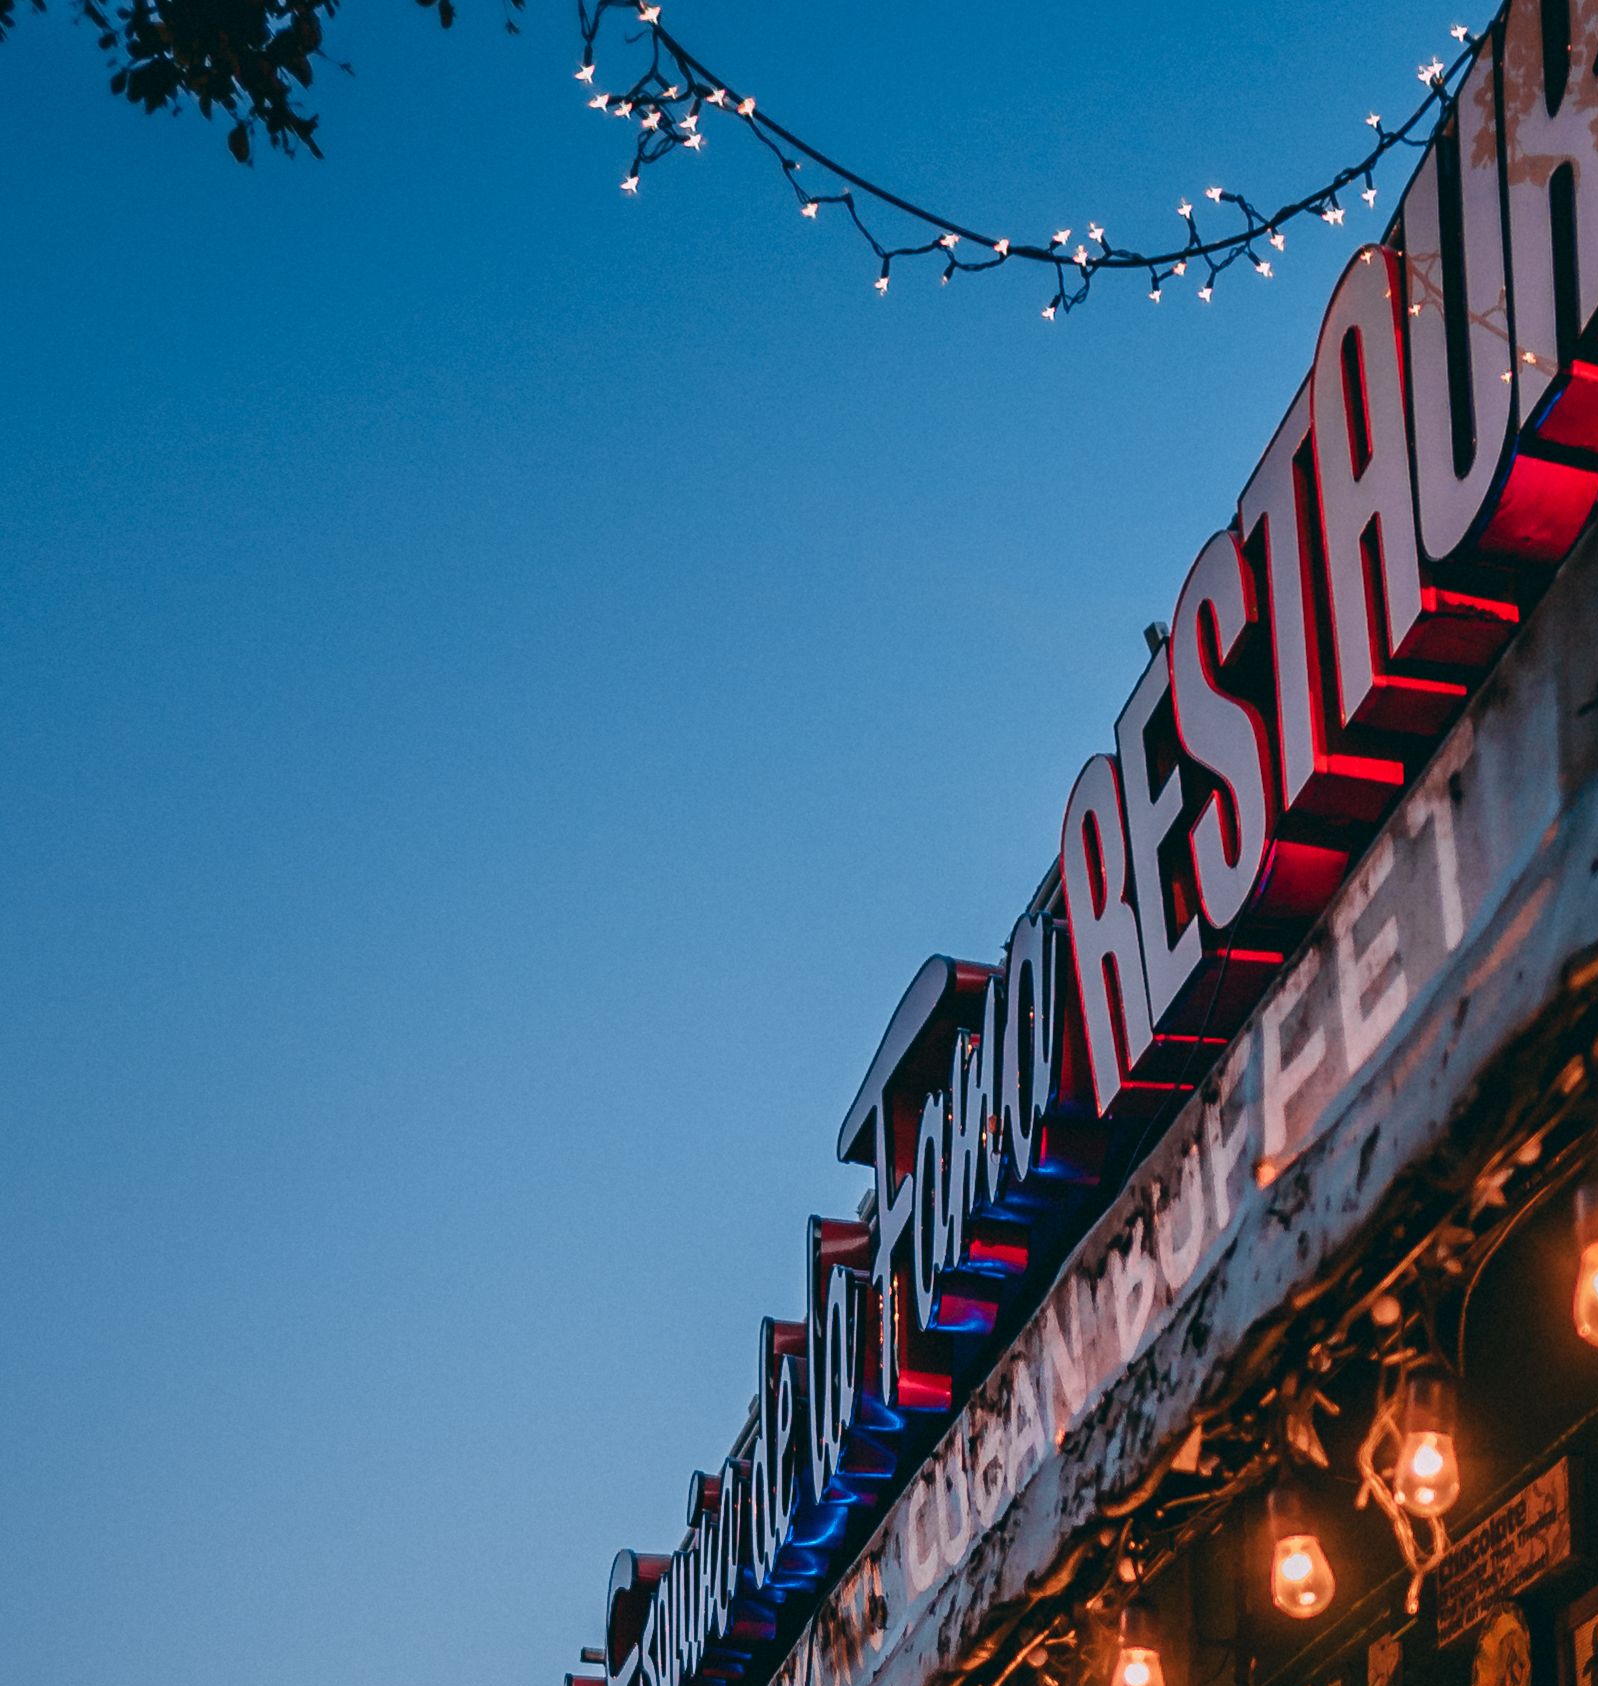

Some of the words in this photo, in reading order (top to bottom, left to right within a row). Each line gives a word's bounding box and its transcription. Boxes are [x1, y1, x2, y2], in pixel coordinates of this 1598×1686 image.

[752, 1316, 795, 1591] de
[807, 1215, 859, 1506] la
[838, 912, 1057, 1406] Fama
